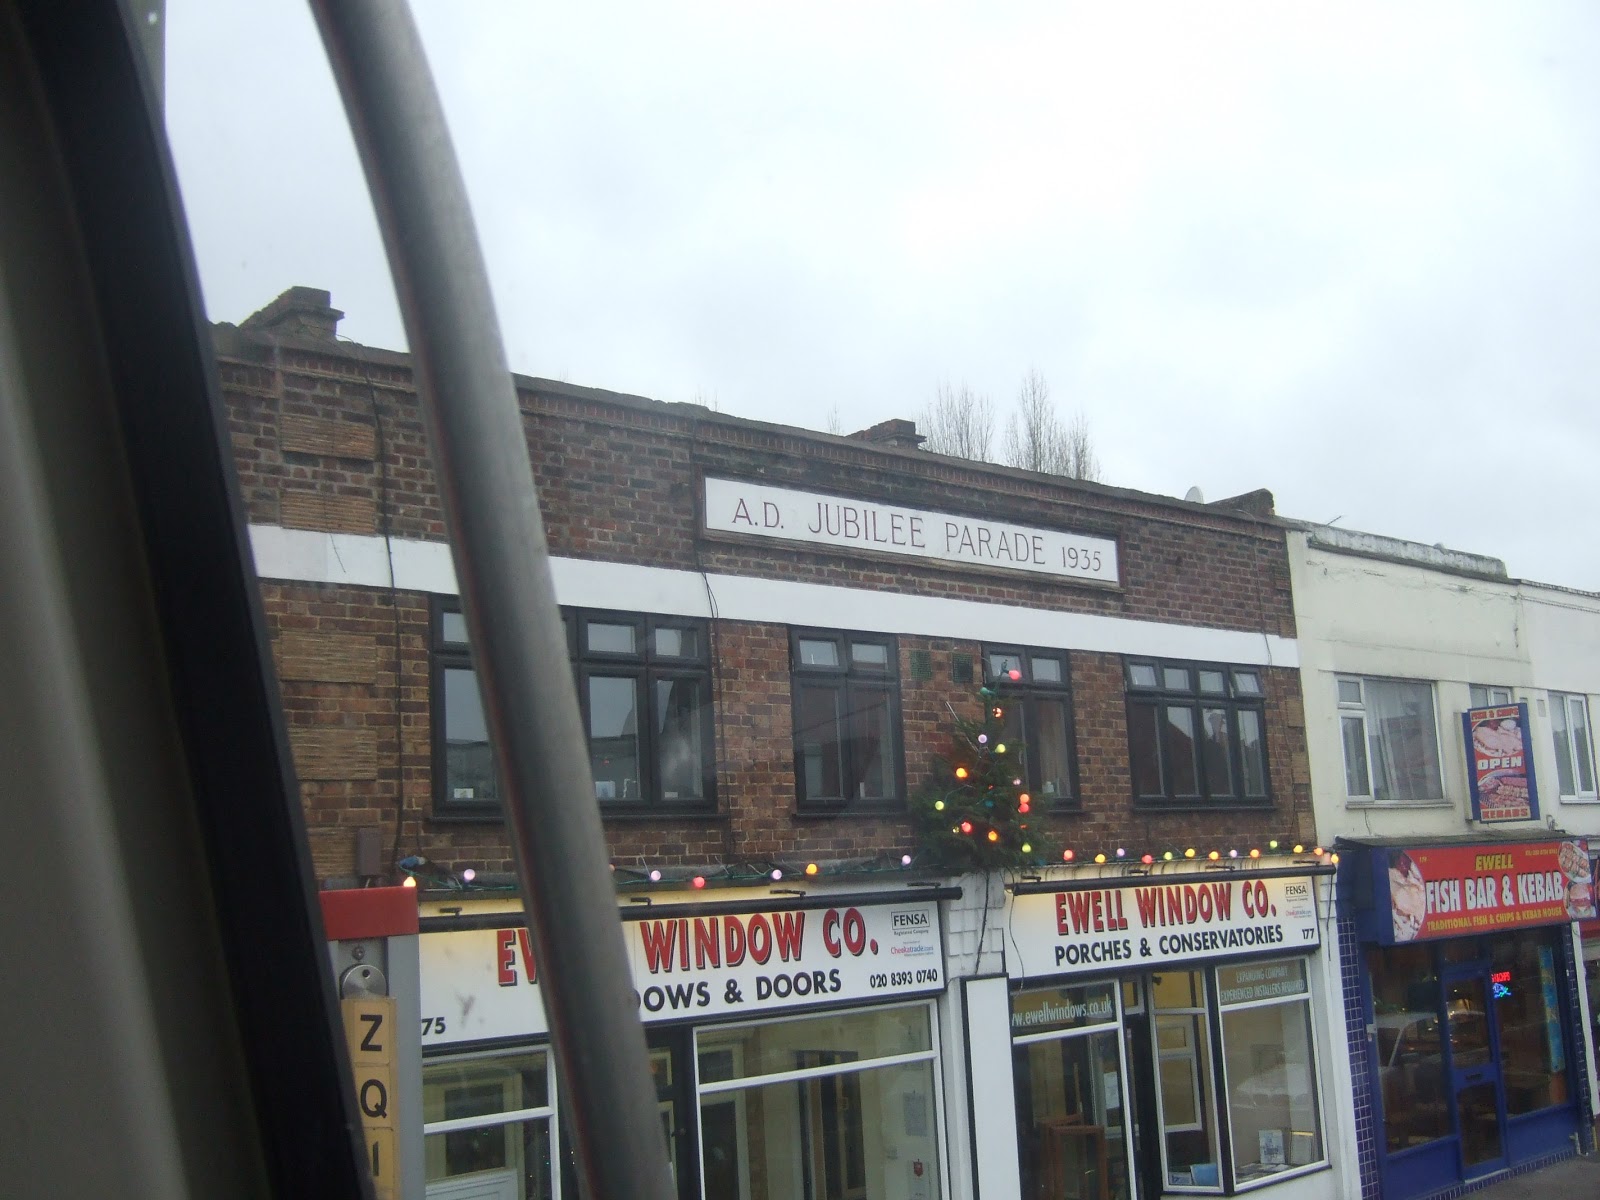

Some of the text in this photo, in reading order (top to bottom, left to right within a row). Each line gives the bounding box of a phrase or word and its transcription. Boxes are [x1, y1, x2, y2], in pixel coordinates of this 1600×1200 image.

[731, 498, 1102, 572] A.D. JUBILEE PARADE 1935
[1477, 756, 1522, 771] OPEN
[1475, 853, 1514, 871] EWELL
[1054, 879, 1277, 936] EWELL WINDOW CO.
[1285, 885, 1307, 895] FENSA
[1425, 870, 1564, 914] FISH BAR & KEBAB
[893, 913, 928, 926] FENSA
[1302, 928, 1315, 940] 177
[1427, 916, 1472, 932] TRADITIONAL
[1473, 915, 1488, 927] FISH
[1495, 912, 1515, 923] CHIPS
[639, 907, 878, 974] WINDOW CO.
[1054, 924, 1283, 966] PORCHES & CONSERVATORIES
[633, 968, 842, 1012] OWS & DOORS
[869, 968, 938, 989] 020 8393 0740
[360, 1014, 383, 1051] Z
[360, 1078, 387, 1118] Q
